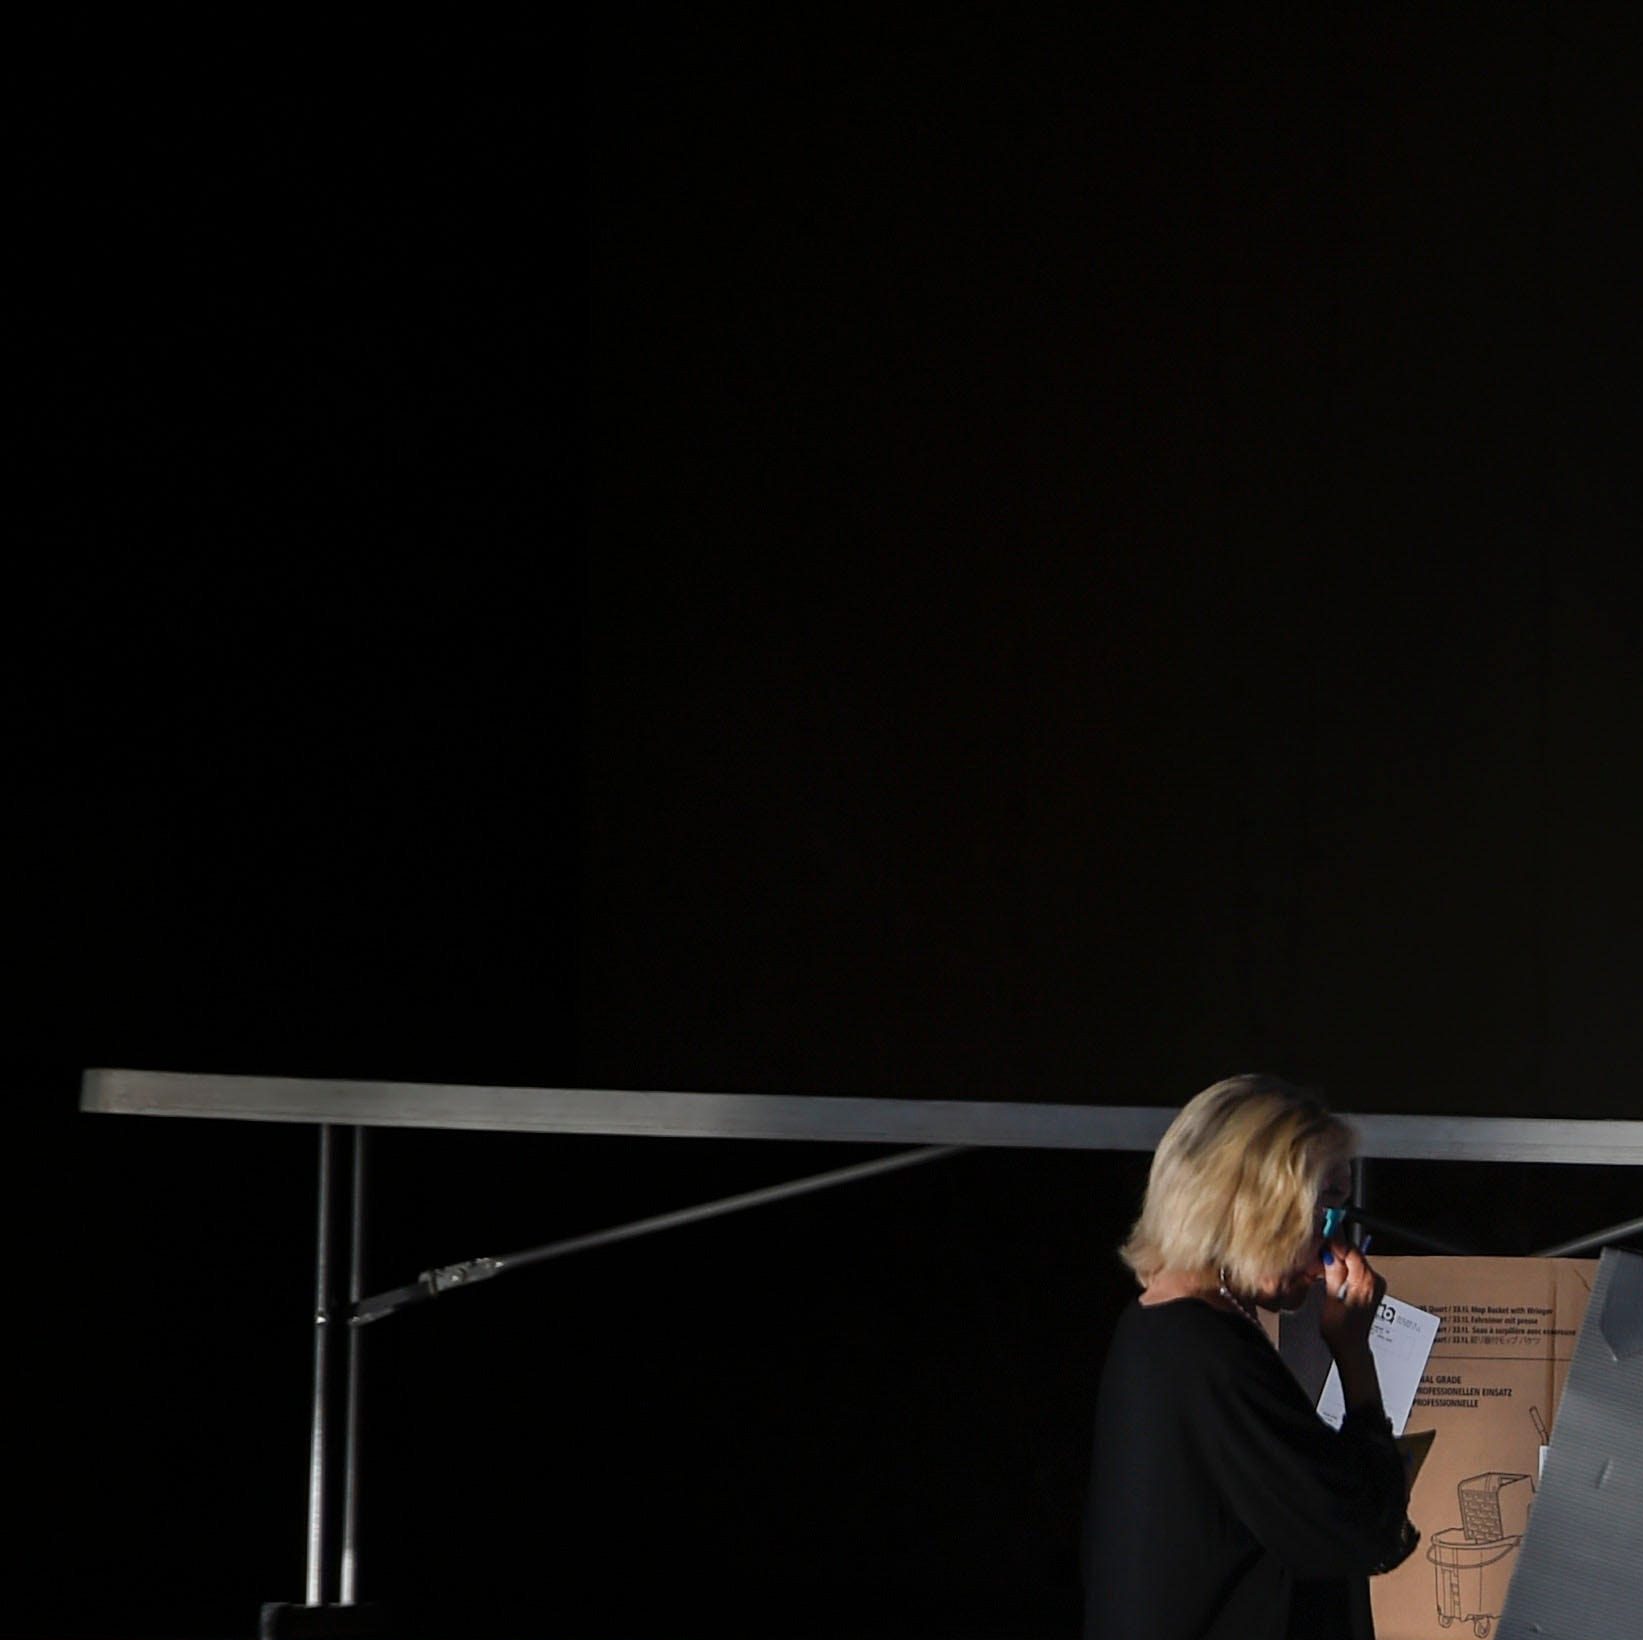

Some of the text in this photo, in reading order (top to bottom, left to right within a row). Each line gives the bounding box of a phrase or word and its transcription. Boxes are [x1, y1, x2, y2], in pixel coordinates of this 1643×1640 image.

[1471, 1306, 1486, 1315] Mop
[1487, 1306, 1509, 1314] Bucket
[1510, 1306, 1526, 1314] with
[1527, 1307, 1553, 1316] Wringer
[1472, 1326, 1488, 1334] Seau
[1435, 1376, 1462, 1385] GRADE
[1482, 1388, 1513, 1397] EINSATZ
